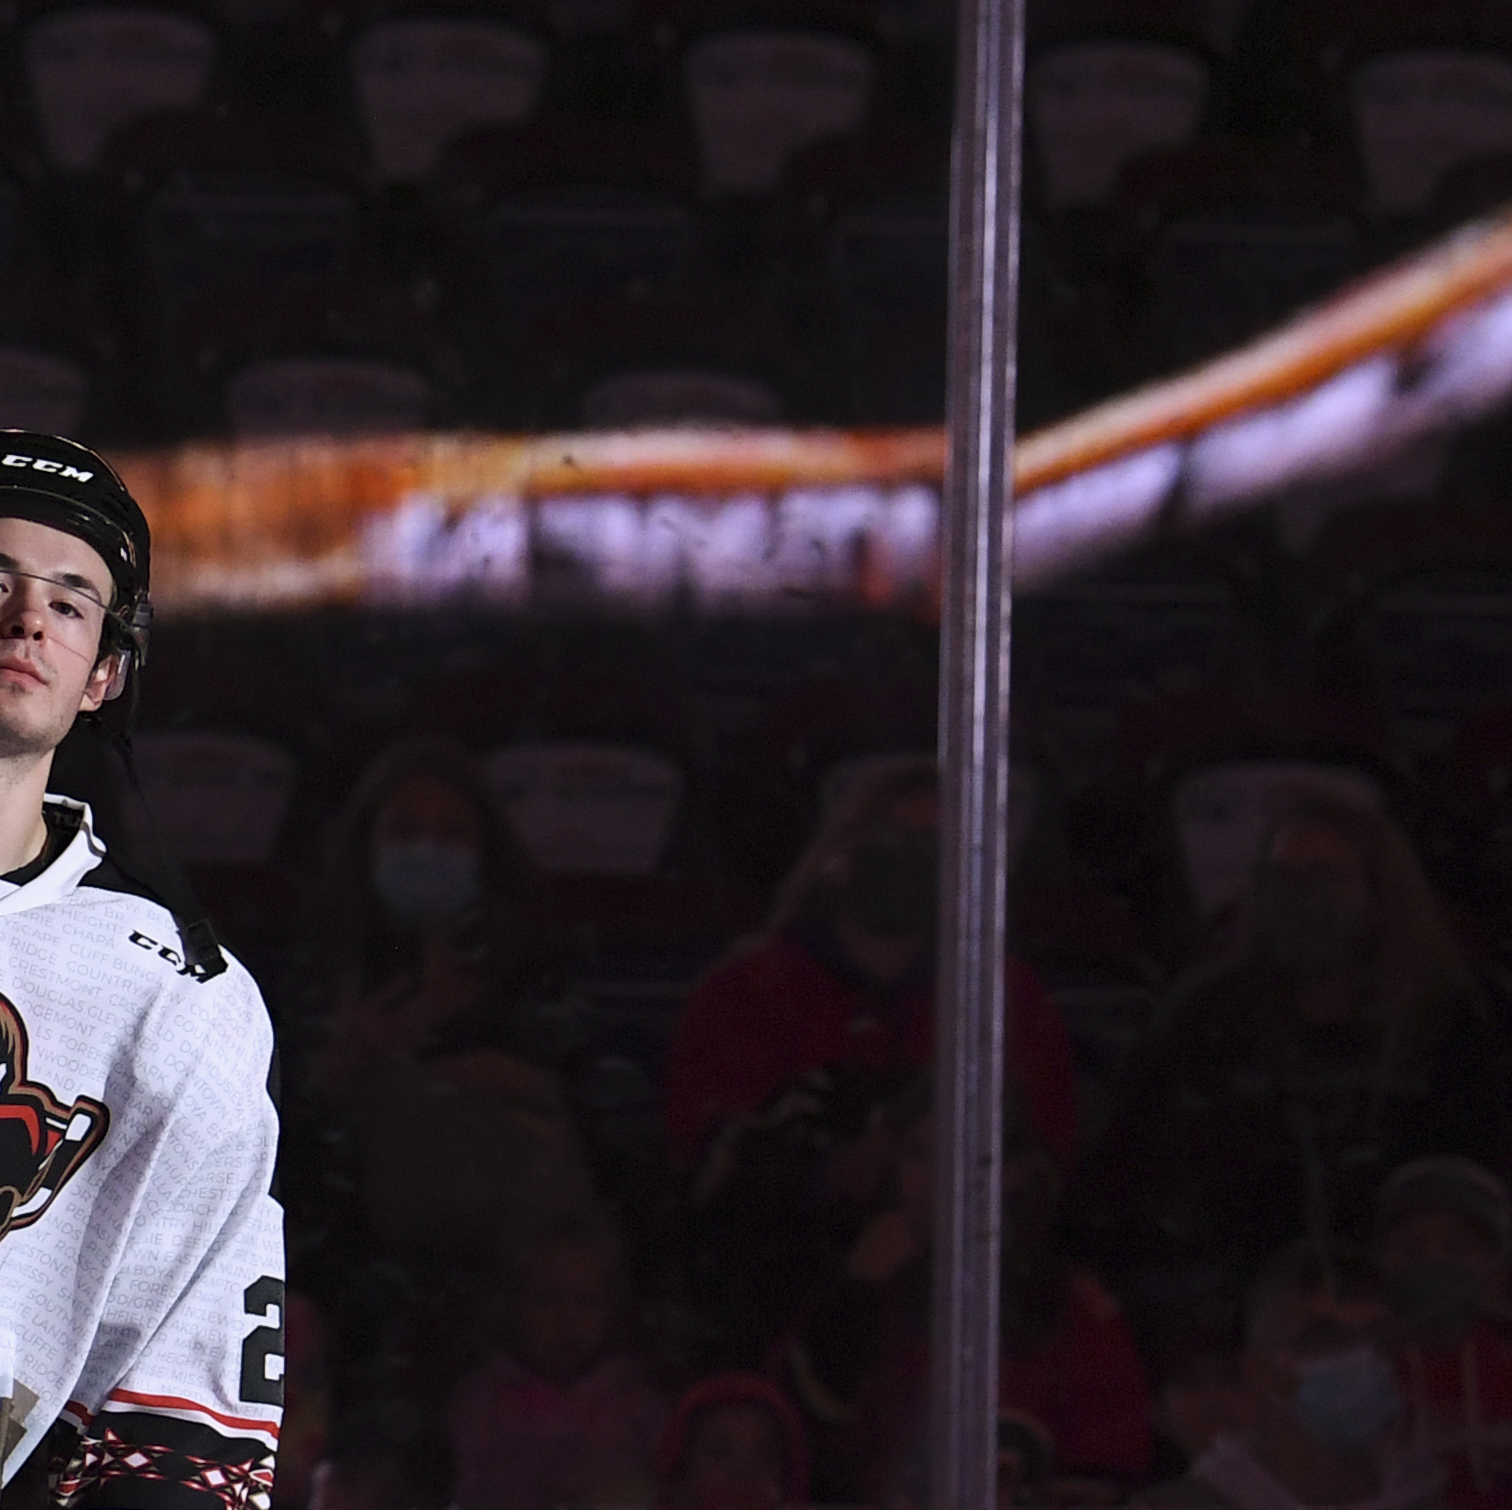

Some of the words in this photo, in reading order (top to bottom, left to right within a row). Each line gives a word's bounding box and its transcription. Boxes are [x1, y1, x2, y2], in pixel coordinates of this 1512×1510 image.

[1, 454, 94, 483] CCM
[6, 955, 103, 999] CRESTMONT
[8, 936, 60, 967] RIDGE
[65, 959, 143, 996] COUNTRY
[12, 976, 84, 1014] DOUGLAS
